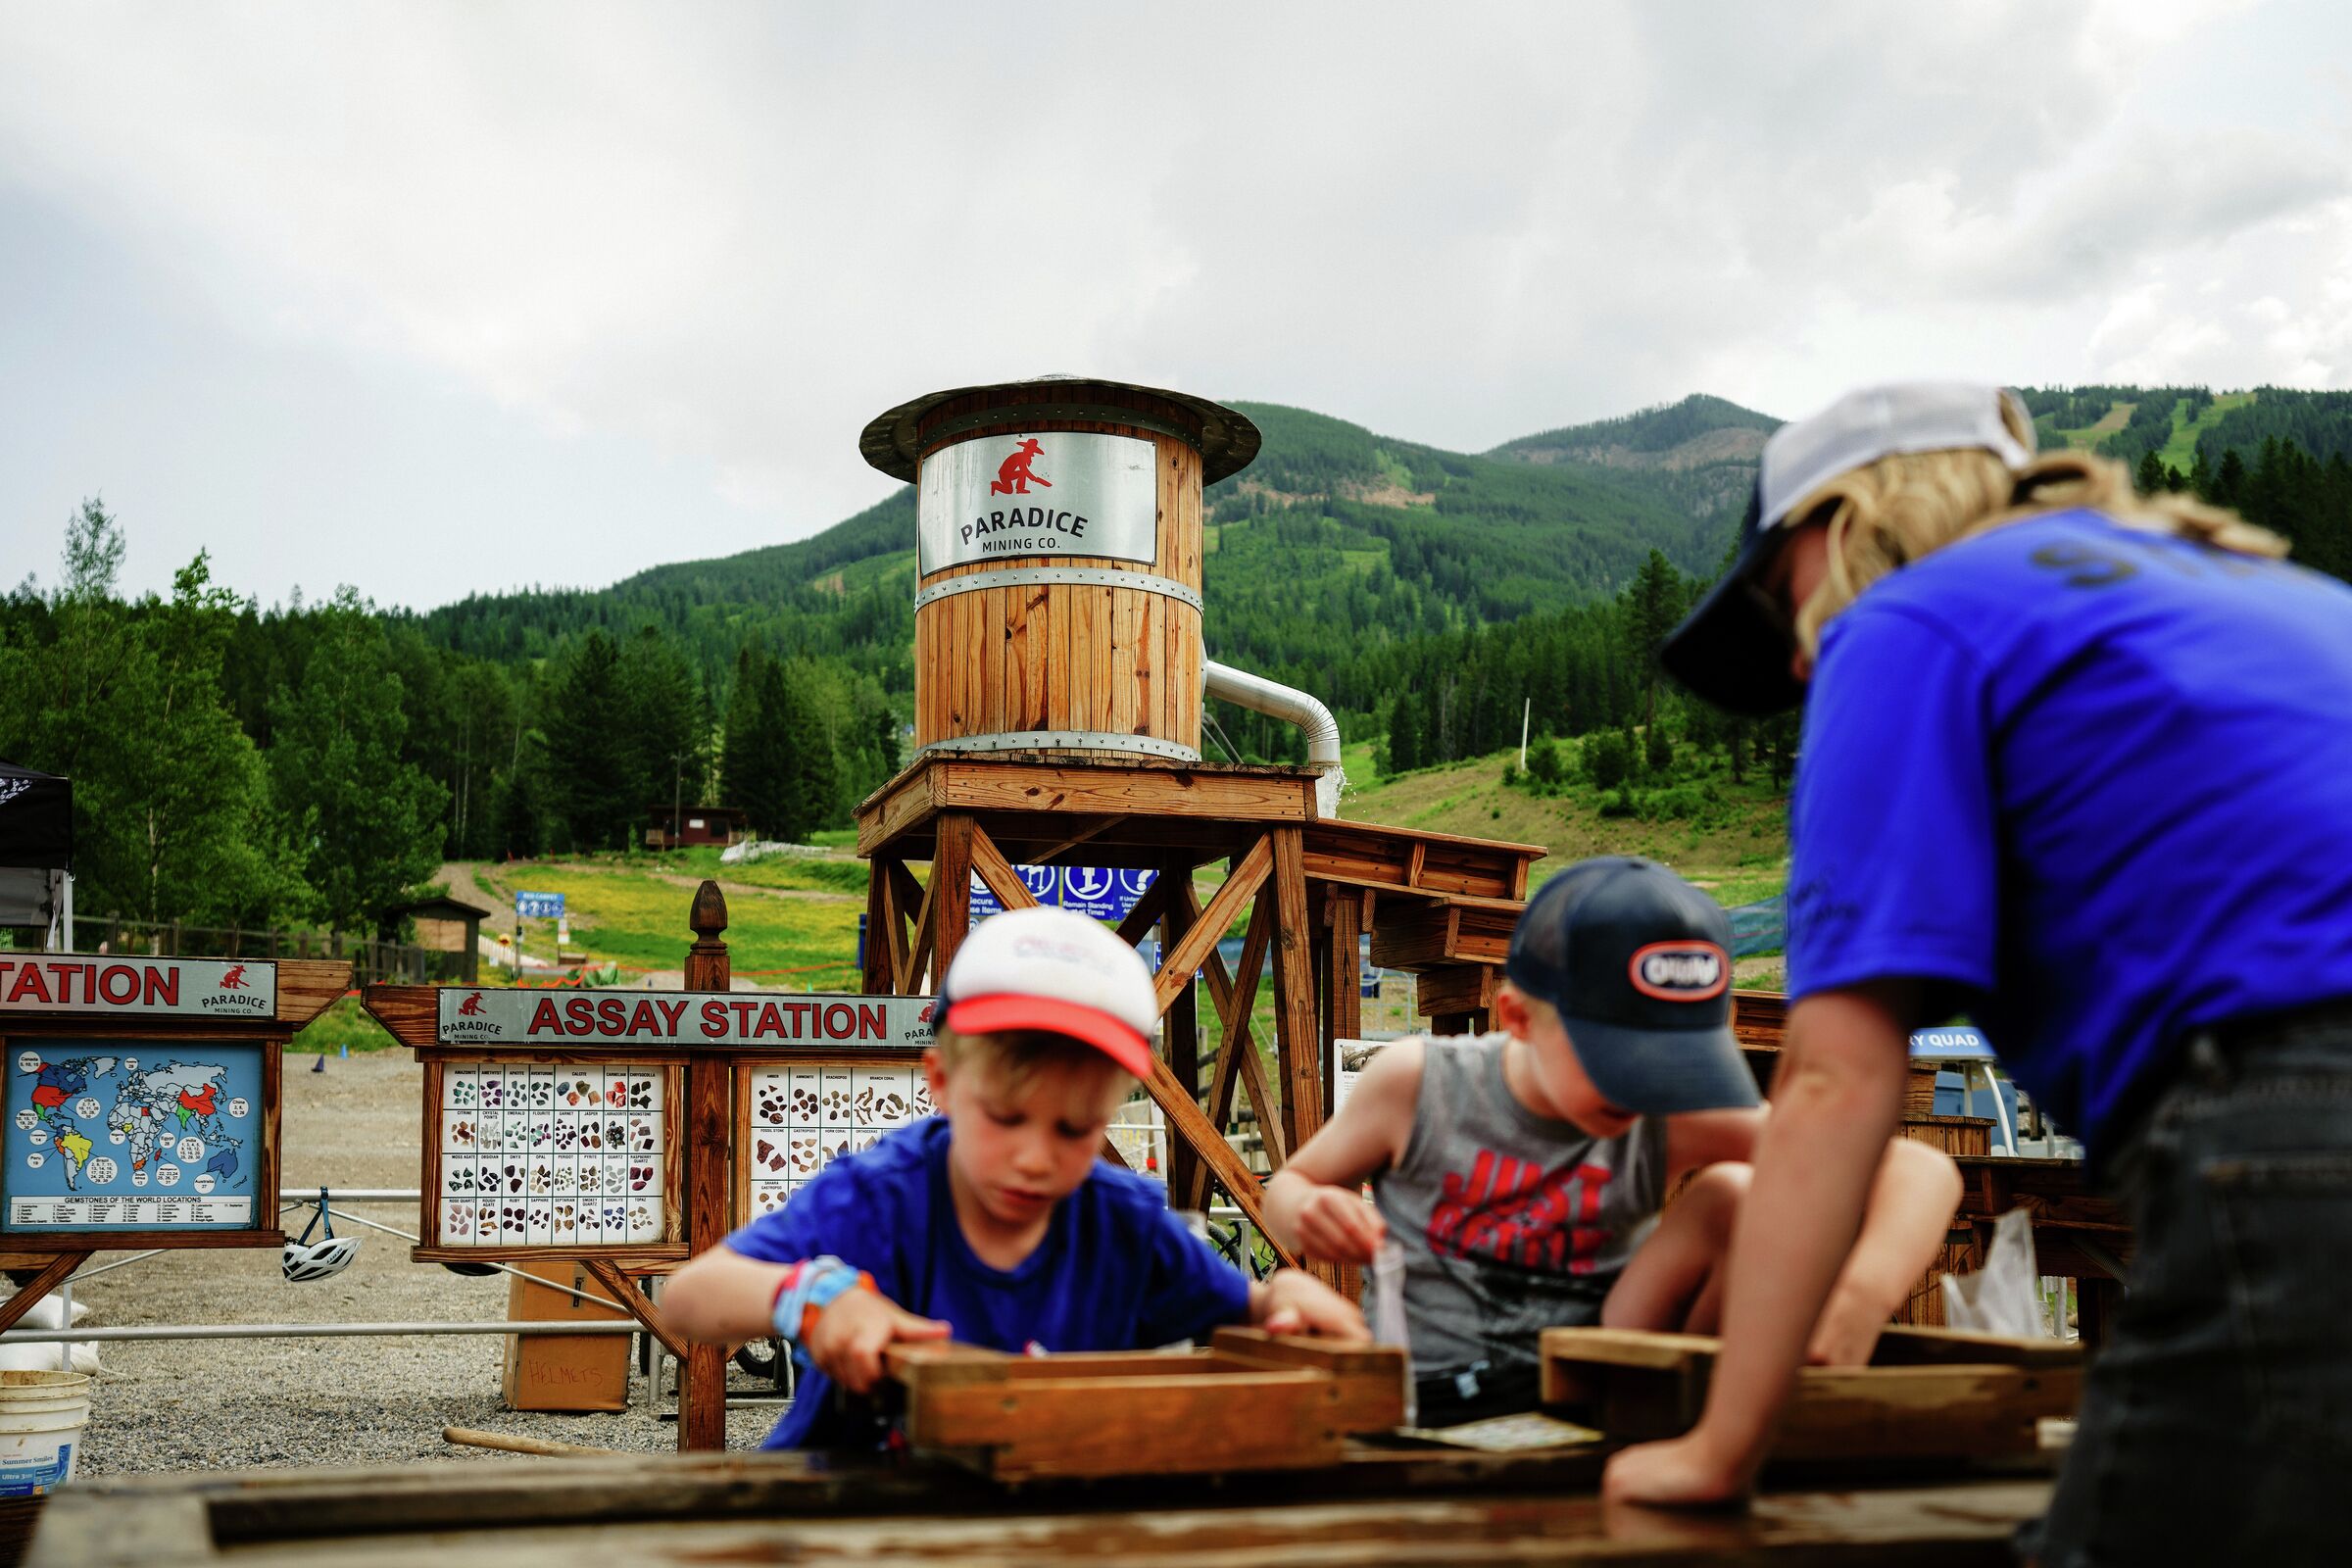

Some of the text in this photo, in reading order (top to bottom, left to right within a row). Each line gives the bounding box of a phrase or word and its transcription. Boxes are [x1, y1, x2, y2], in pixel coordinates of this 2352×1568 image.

[960, 507, 1089, 545] PARADICE
[982, 537, 1061, 553] MINING CO.
[1088, 901, 1114, 911] Standing
[201, 994, 267, 1009] PARADICE
[527, 997, 886, 1040] ASSAY STATION
[442, 1021, 502, 1035] PARADICE
[905, 1029, 933, 1040] PARA
[1928, 1034, 1979, 1047] QUAD
[1442, 1149, 1613, 1225] JUST
[529, 1359, 604, 1387] HELMETS
